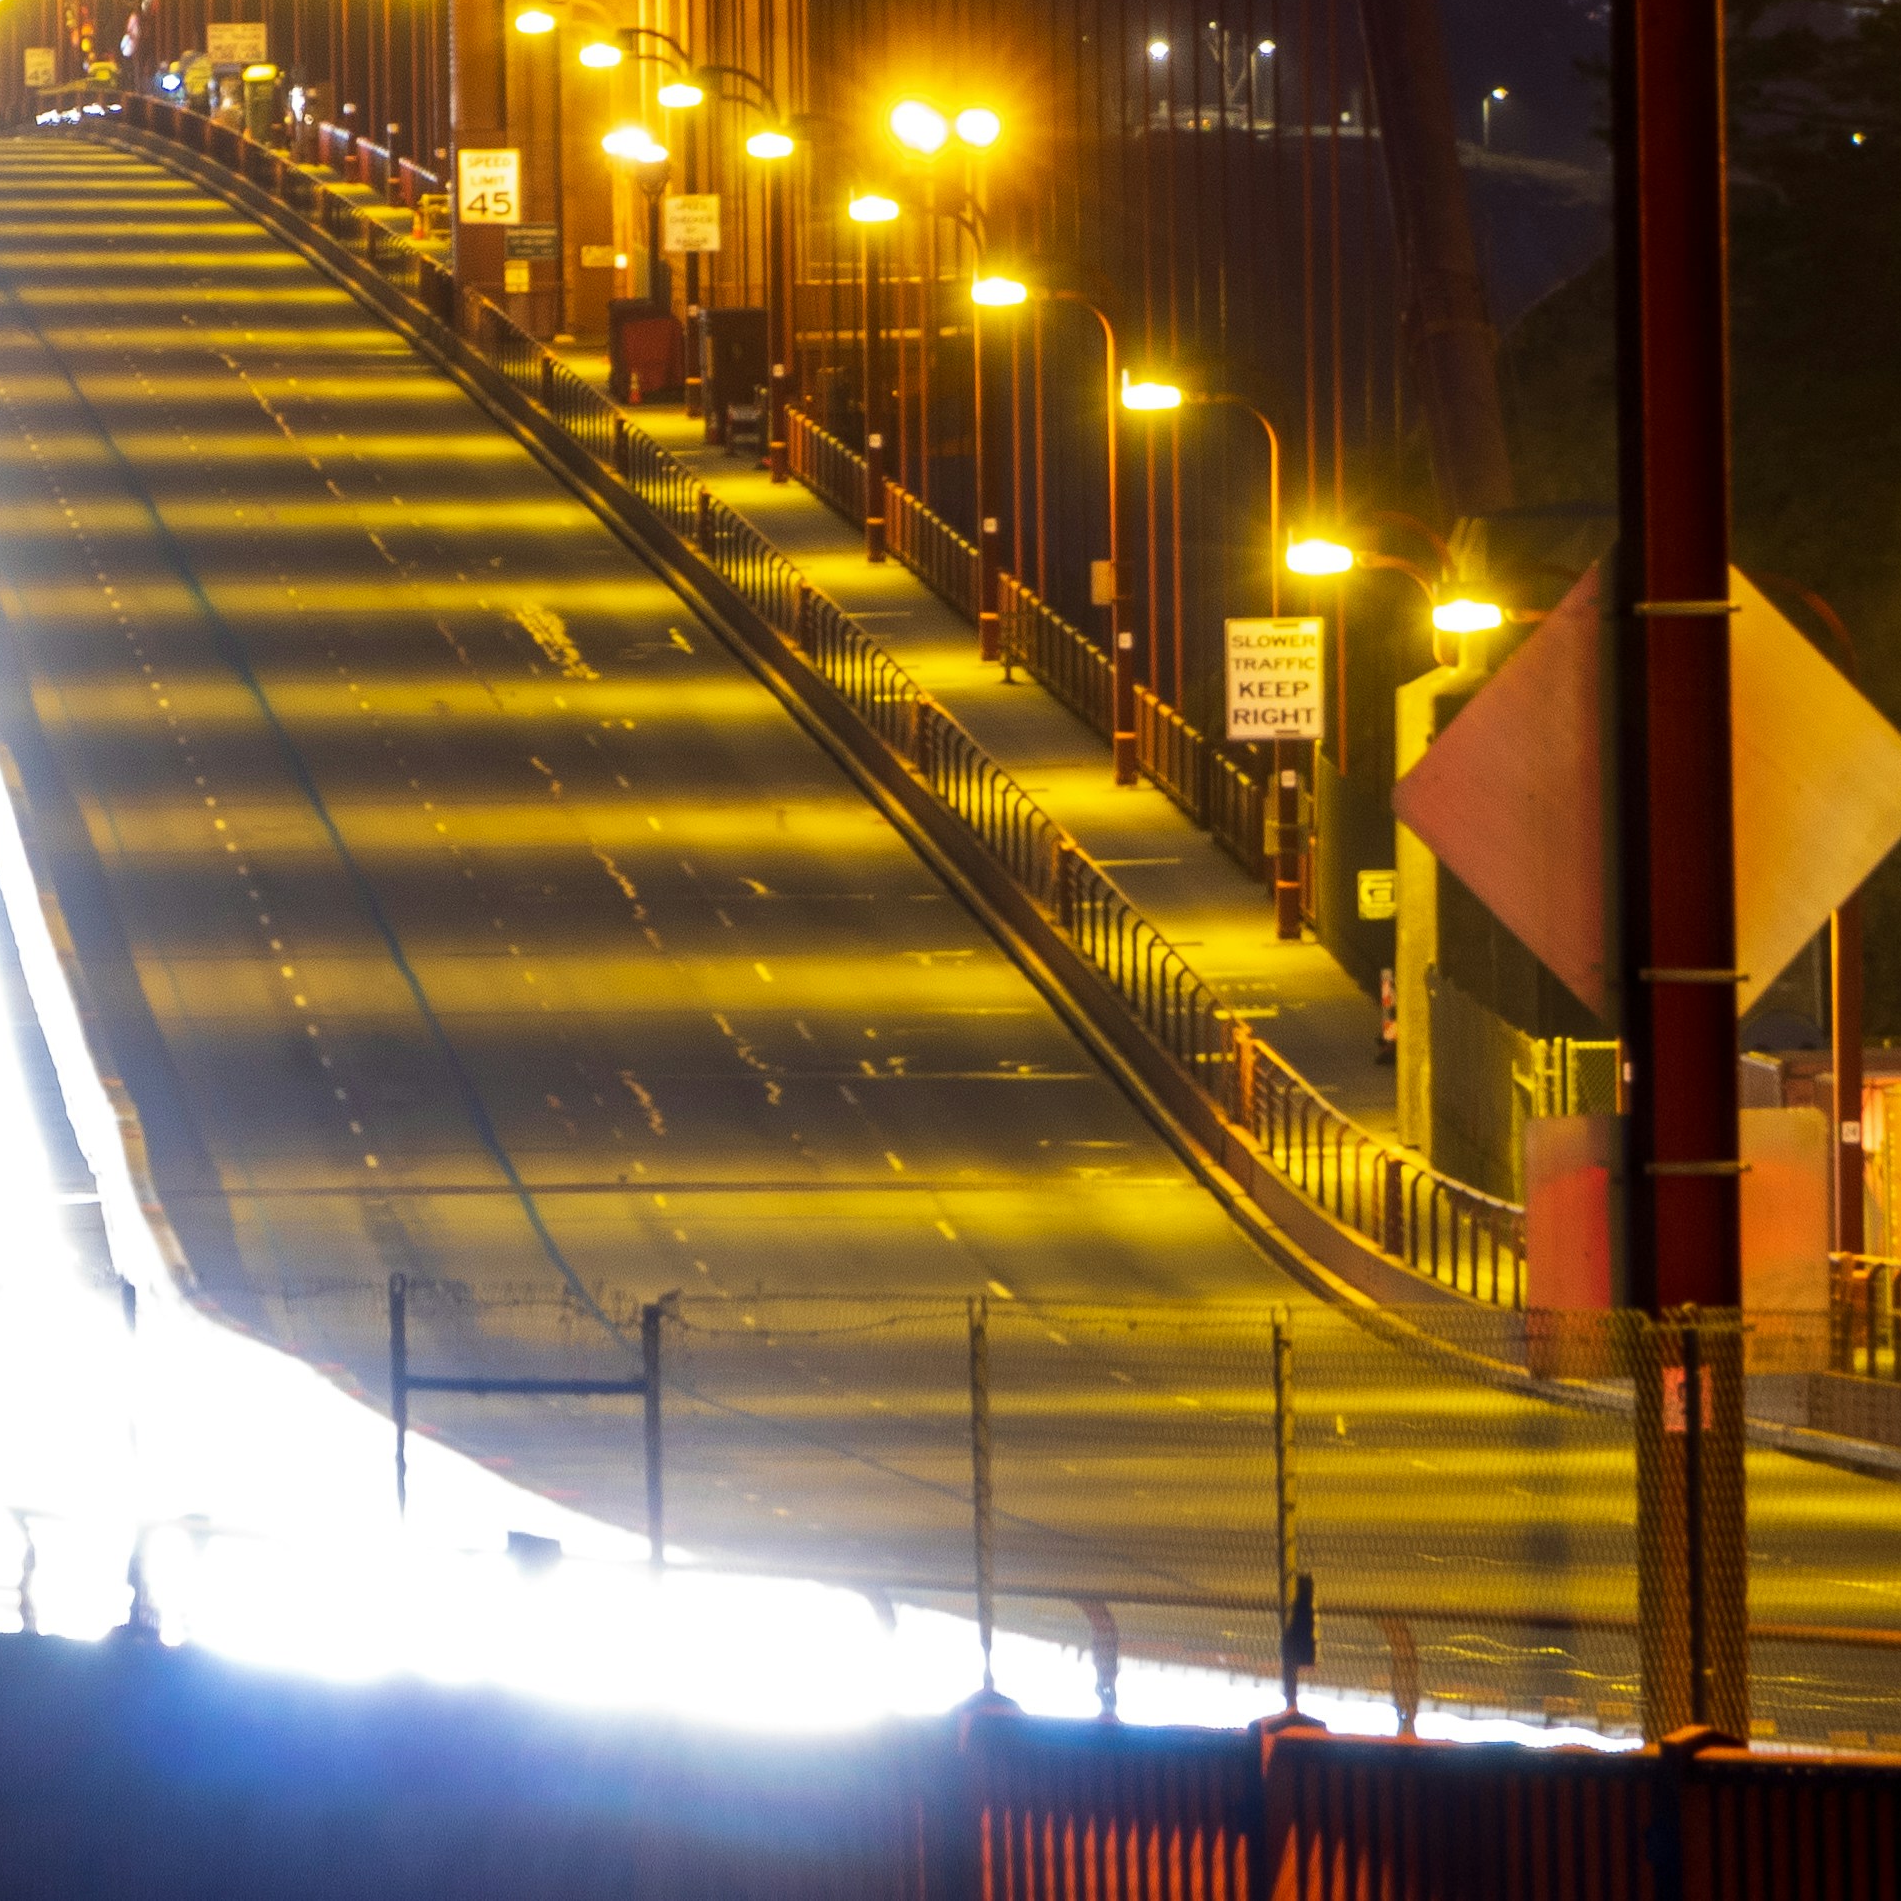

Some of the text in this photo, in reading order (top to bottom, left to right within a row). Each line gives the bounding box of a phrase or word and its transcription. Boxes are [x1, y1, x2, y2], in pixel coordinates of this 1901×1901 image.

[467, 155, 511, 168] SPEED
[470, 175, 505, 187] LIMIT
[466, 191, 512, 216] 45
[1231, 634, 1316, 649] SLOWER
[1231, 657, 1316, 671] TRAFFIC
[1238, 680, 1310, 698] KEEP
[1233, 707, 1316, 725] RIGHT
